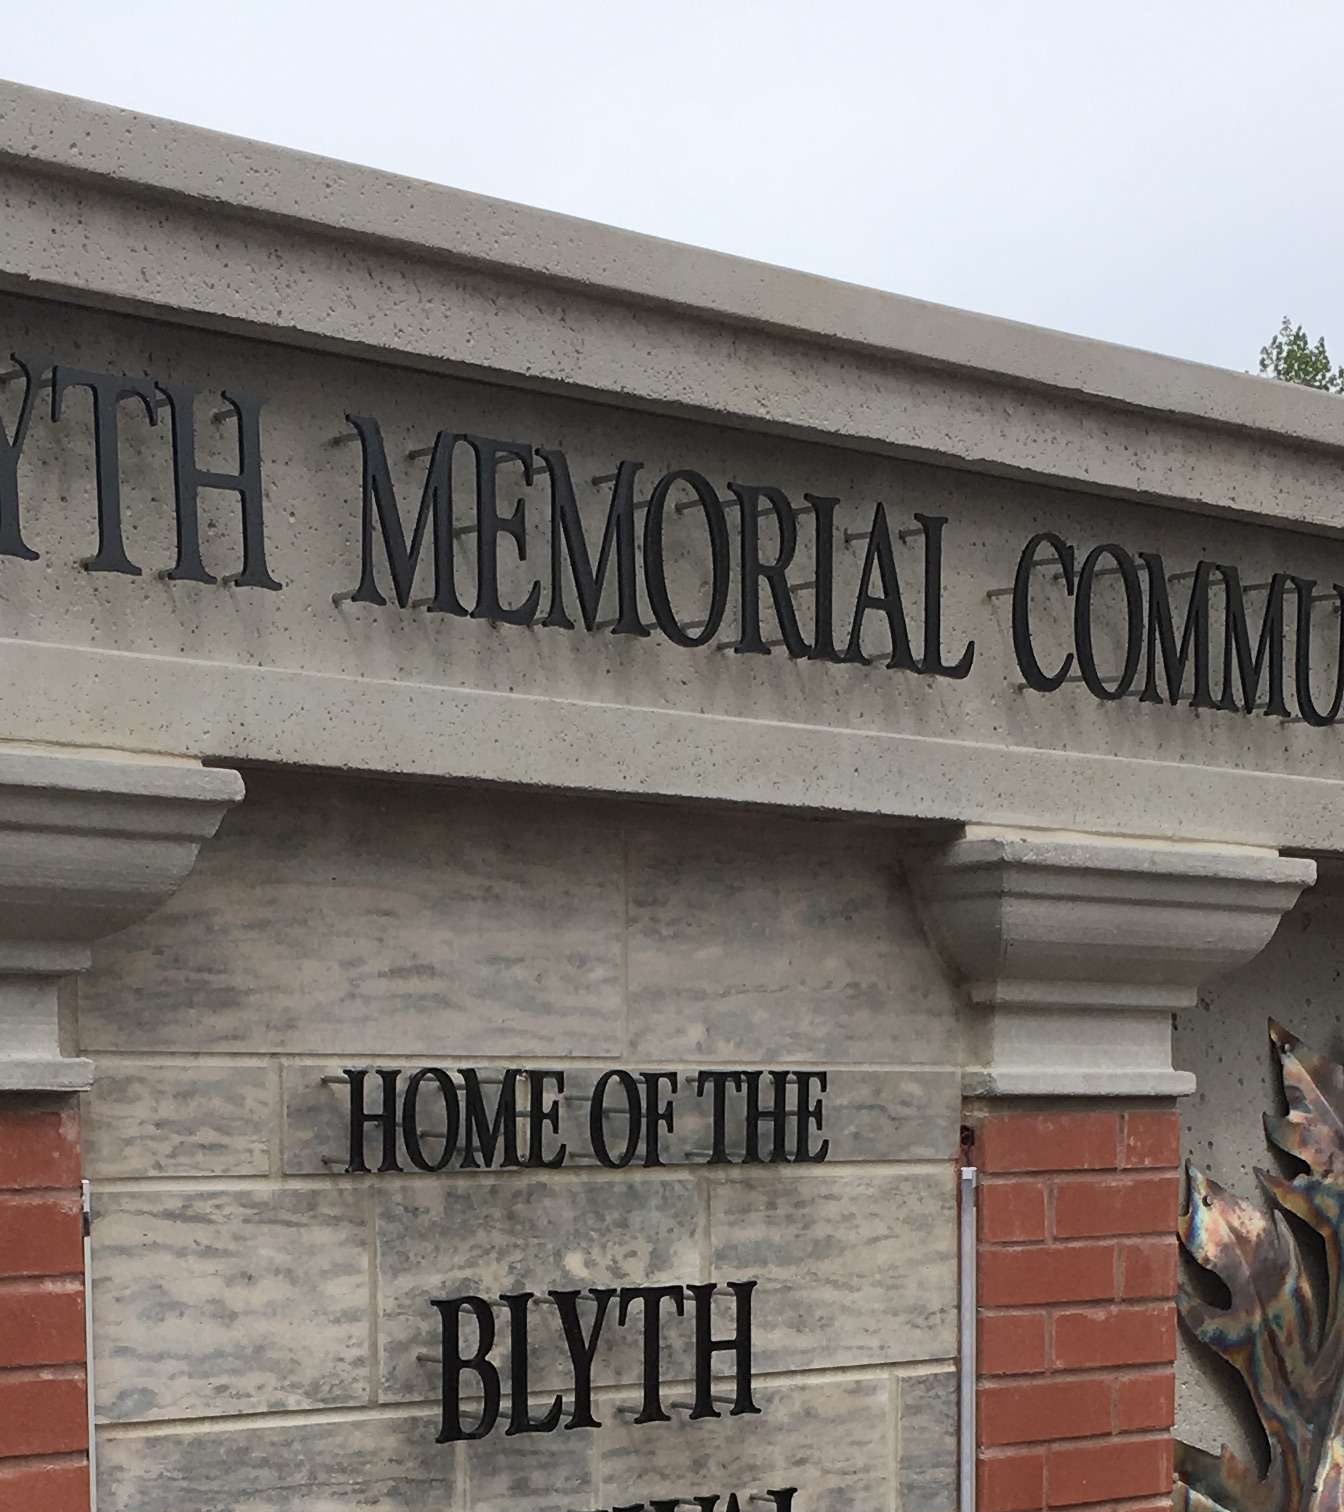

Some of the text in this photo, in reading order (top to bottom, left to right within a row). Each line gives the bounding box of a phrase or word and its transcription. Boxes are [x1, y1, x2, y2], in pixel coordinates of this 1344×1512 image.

[344, 413, 975, 679] MEMORIAL
[342, 1067, 830, 1173] HOME OF THE
[430, 1281, 762, 1444] BLYTH
